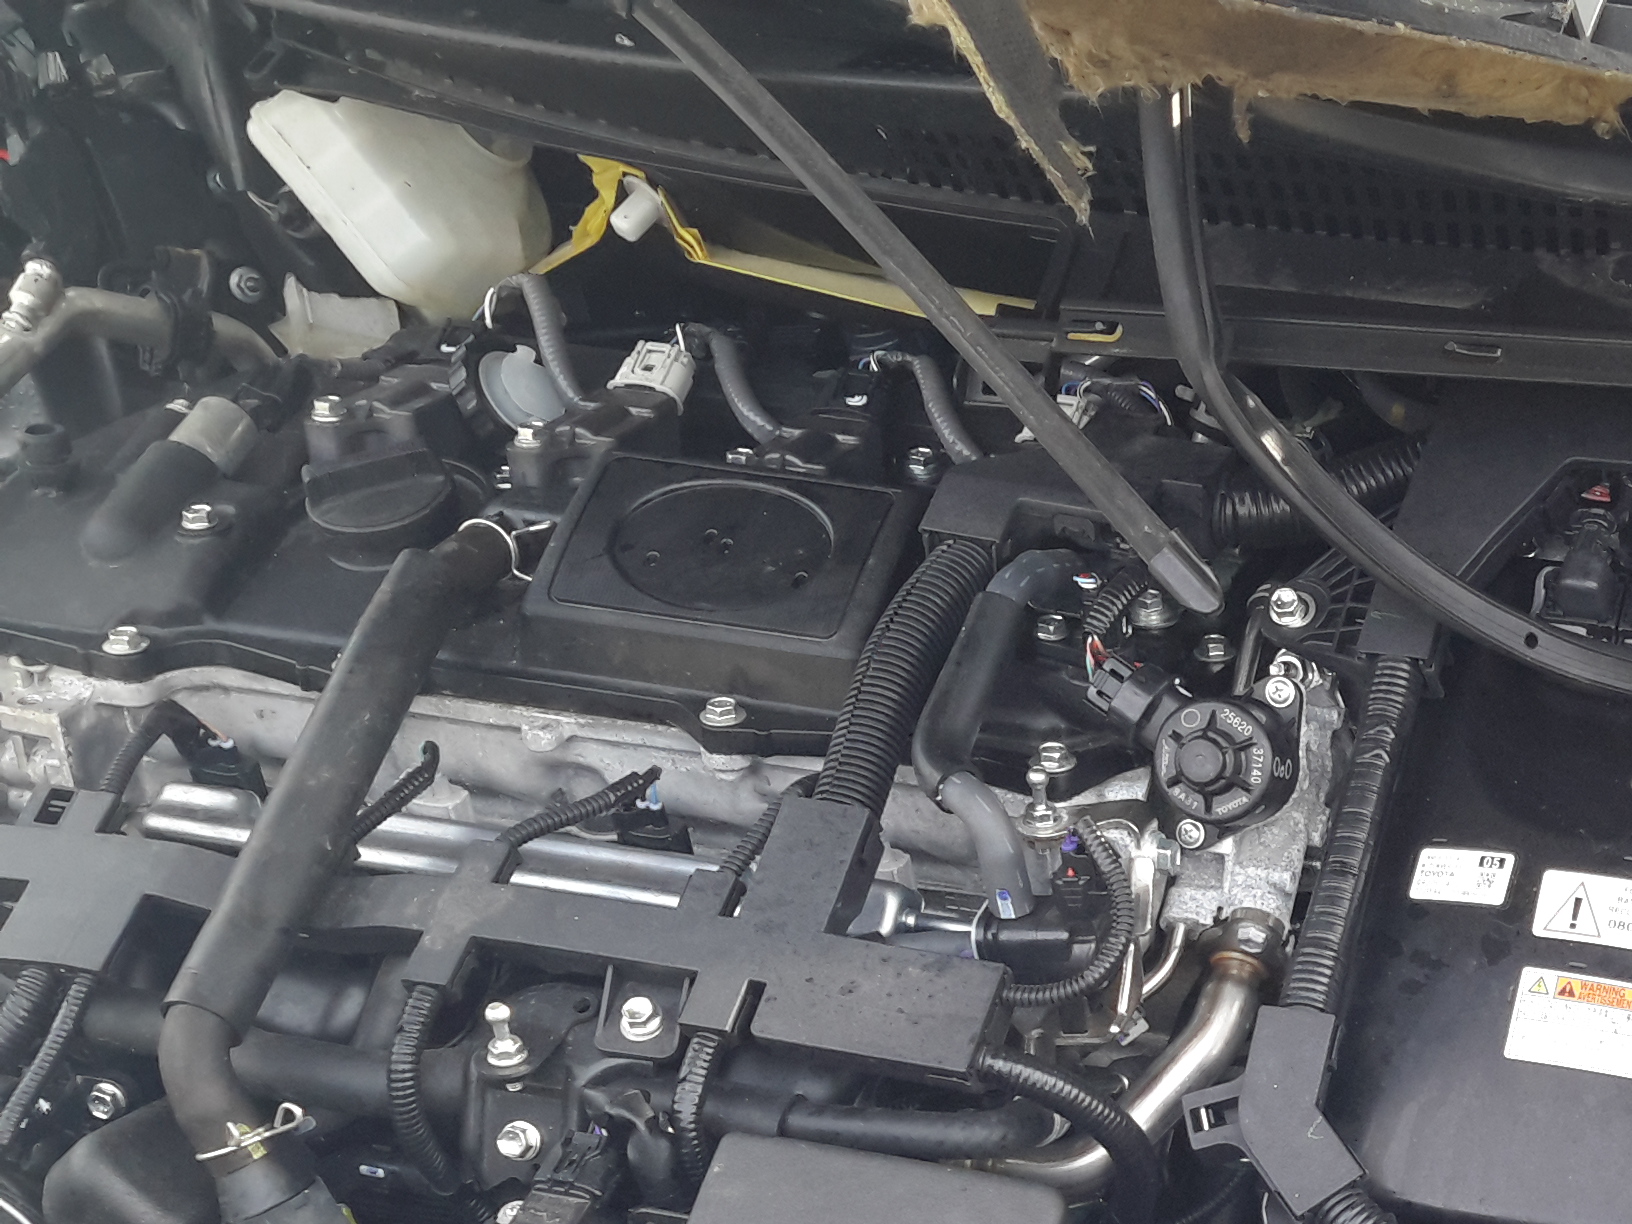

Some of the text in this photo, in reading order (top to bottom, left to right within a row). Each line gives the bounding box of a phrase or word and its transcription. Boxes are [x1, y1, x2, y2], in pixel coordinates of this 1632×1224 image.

[1220, 708, 1253, 736] 25620
[1250, 747, 1264, 784] 37140
[1215, 796, 1249, 815] TOYOTA
[1483, 856, 1501, 869] 05
[1580, 981, 1626, 999] WARNING
